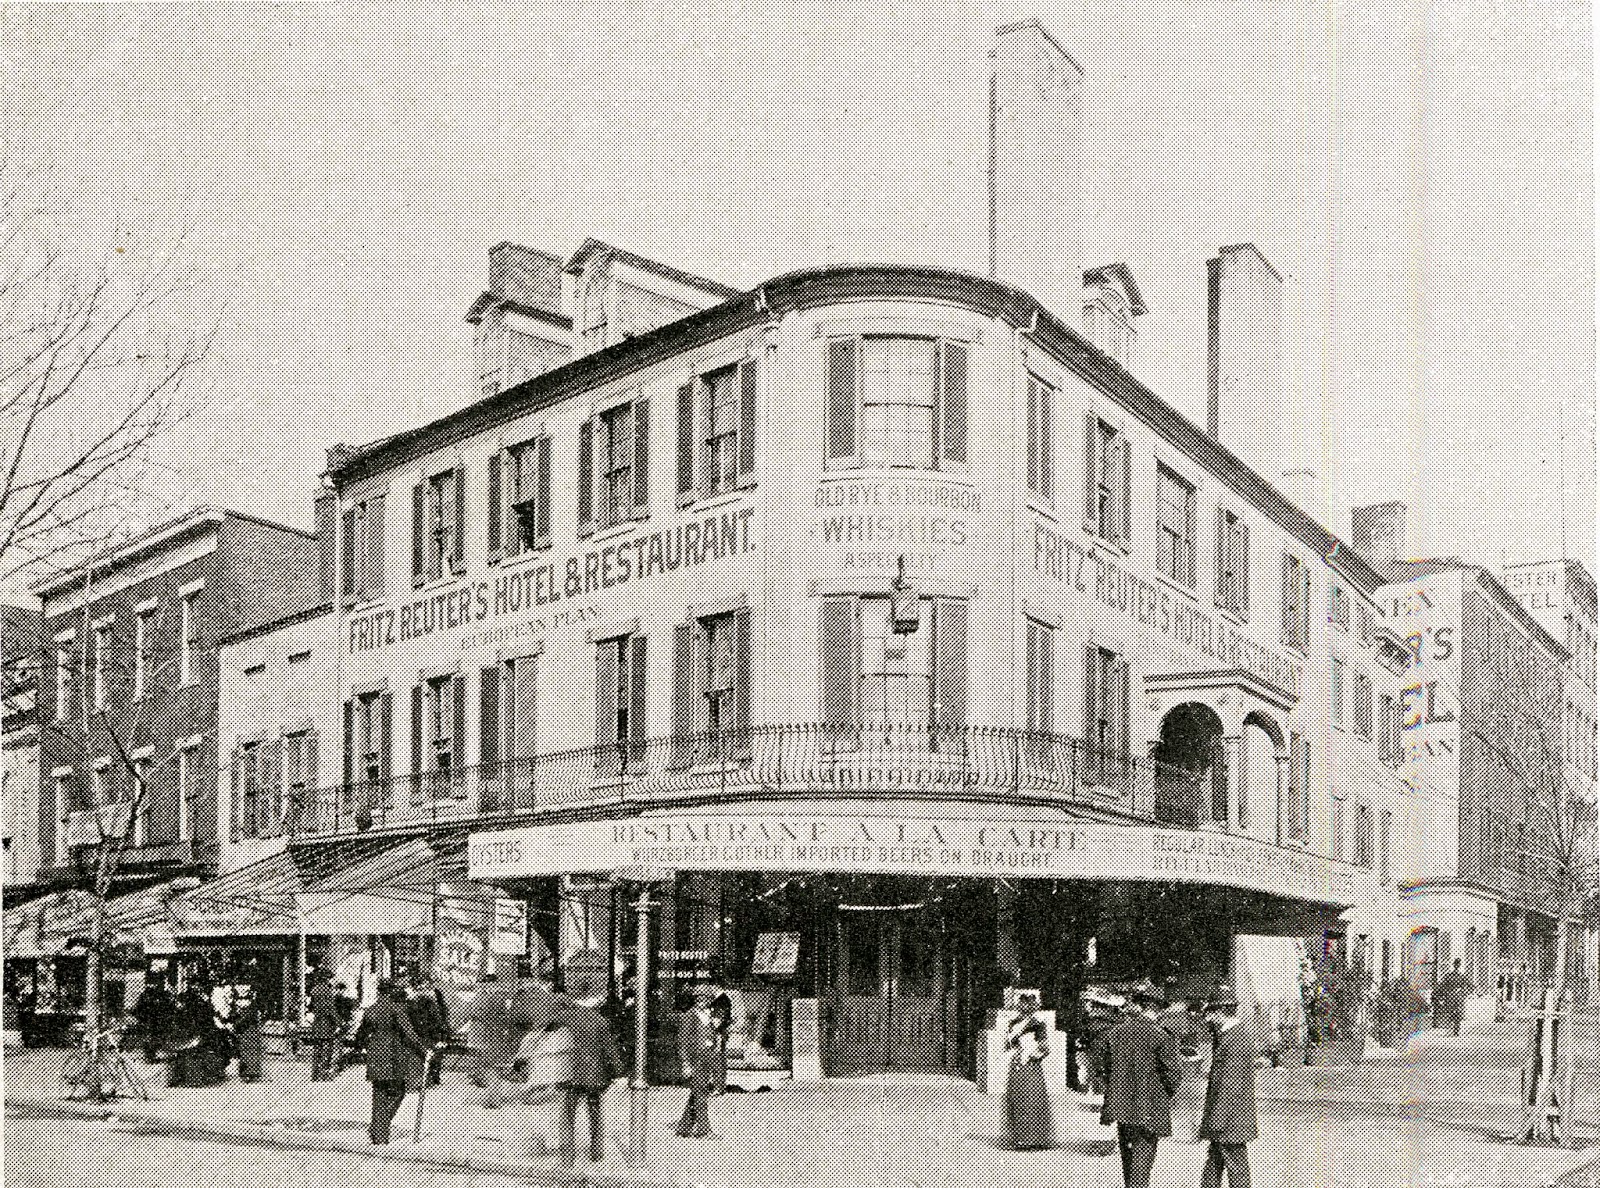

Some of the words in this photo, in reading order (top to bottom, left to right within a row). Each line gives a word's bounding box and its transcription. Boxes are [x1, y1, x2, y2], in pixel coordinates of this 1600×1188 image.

[813, 485, 845, 509] OLD
[848, 483, 884, 506] RYE
[904, 485, 982, 514] BOURBON
[822, 515, 968, 546] WHISKIES
[857, 552, 938, 570] SPECLTY
[1033, 522, 1086, 593] FRITZ
[1095, 553, 1170, 634] REUTER'S
[1174, 598, 1215, 658] HOTEL
[349, 605, 396, 656] FRITZ
[400, 581, 488, 644] REUTER'S
[494, 563, 561, 617] HOTEL
[460, 618, 546, 652] EUROPEAN
[552, 604, 600, 630] PLAN
[612, 822, 828, 843] RESTAURANT
[851, 822, 875, 842] A
[977, 827, 1087, 851] CARTE
[471, 840, 522, 867] OYSTERS
[735, 845, 784, 862] OTHER
[790, 845, 871, 863] IMPORTED
[878, 846, 933, 865] BEERS
[939, 848, 962, 866] ON
[438, 948, 480, 970] SALE
